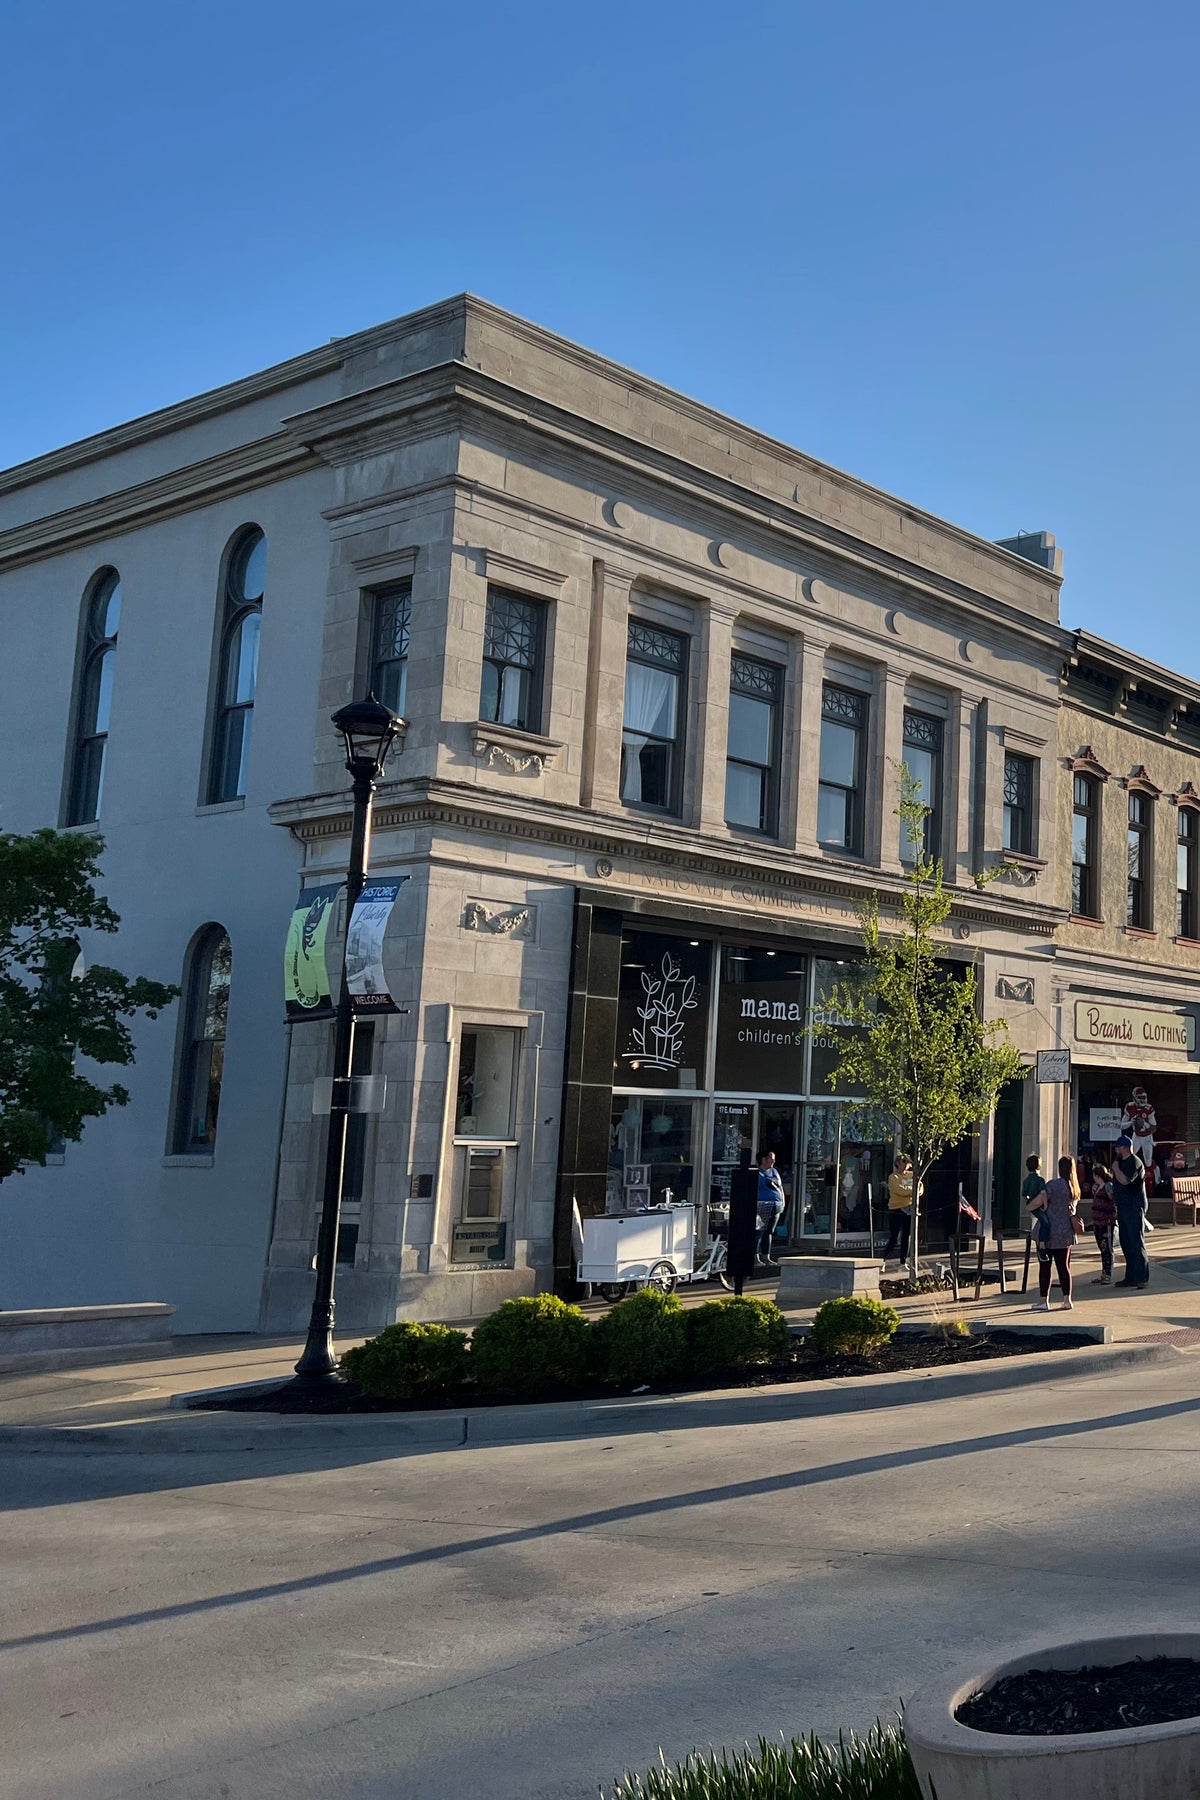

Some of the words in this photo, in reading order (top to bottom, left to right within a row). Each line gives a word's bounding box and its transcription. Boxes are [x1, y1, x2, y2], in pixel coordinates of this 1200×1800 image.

[361, 886, 397, 897] HISTORIC
[642, 871, 722, 897] NATIONAL
[731, 884, 832, 915] COMMERCIAL
[354, 995, 389, 1005] WELCOME
[740, 998, 801, 1021] mama
[1087, 1007, 1132, 1040] Brant's
[1143, 1022, 1187, 1045] CLOTHING
[737, 1028, 800, 1046] children's
[1042, 1052, 1069, 1065] Liberty
